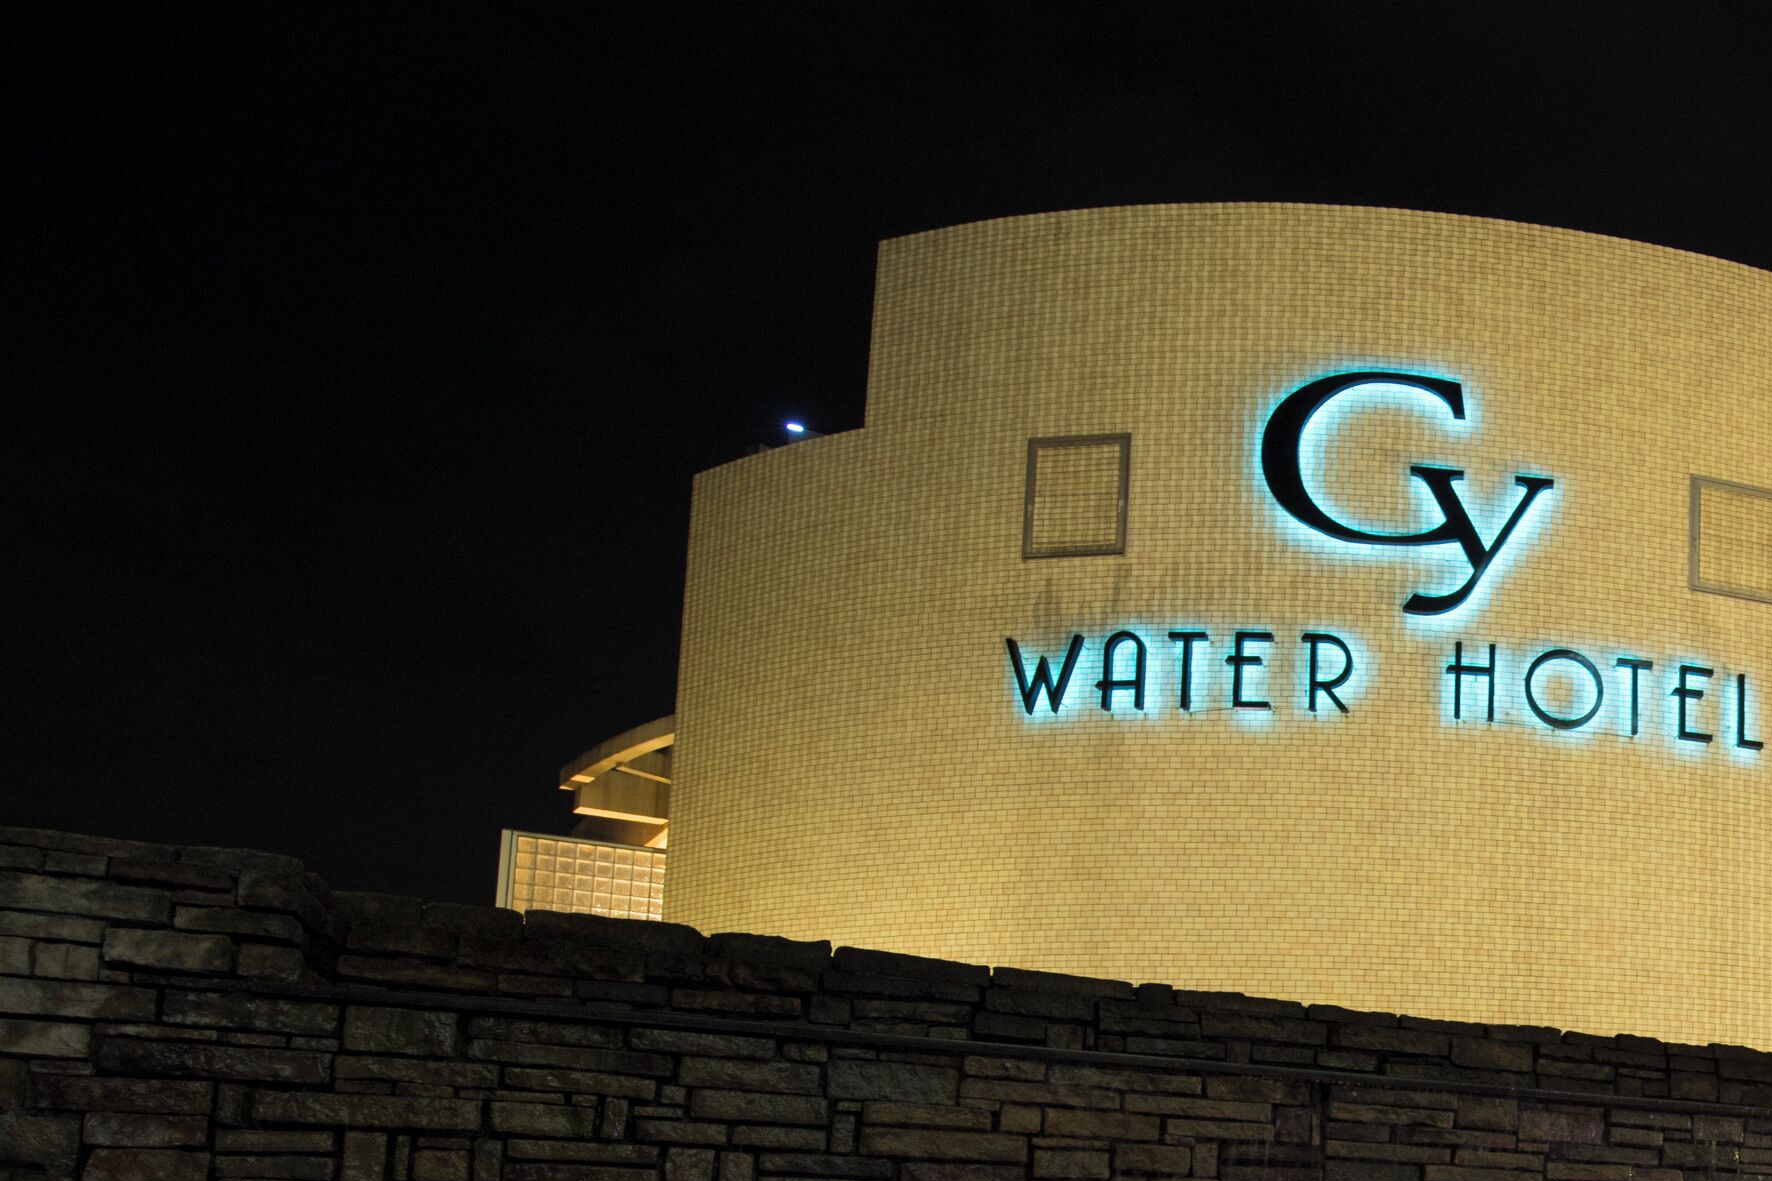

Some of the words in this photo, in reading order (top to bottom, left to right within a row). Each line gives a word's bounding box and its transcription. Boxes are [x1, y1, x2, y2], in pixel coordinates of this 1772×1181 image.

[1261, 371, 1554, 615] Gy
[1006, 629, 1355, 716] WATER
[1446, 641, 1764, 751] HOTEL
